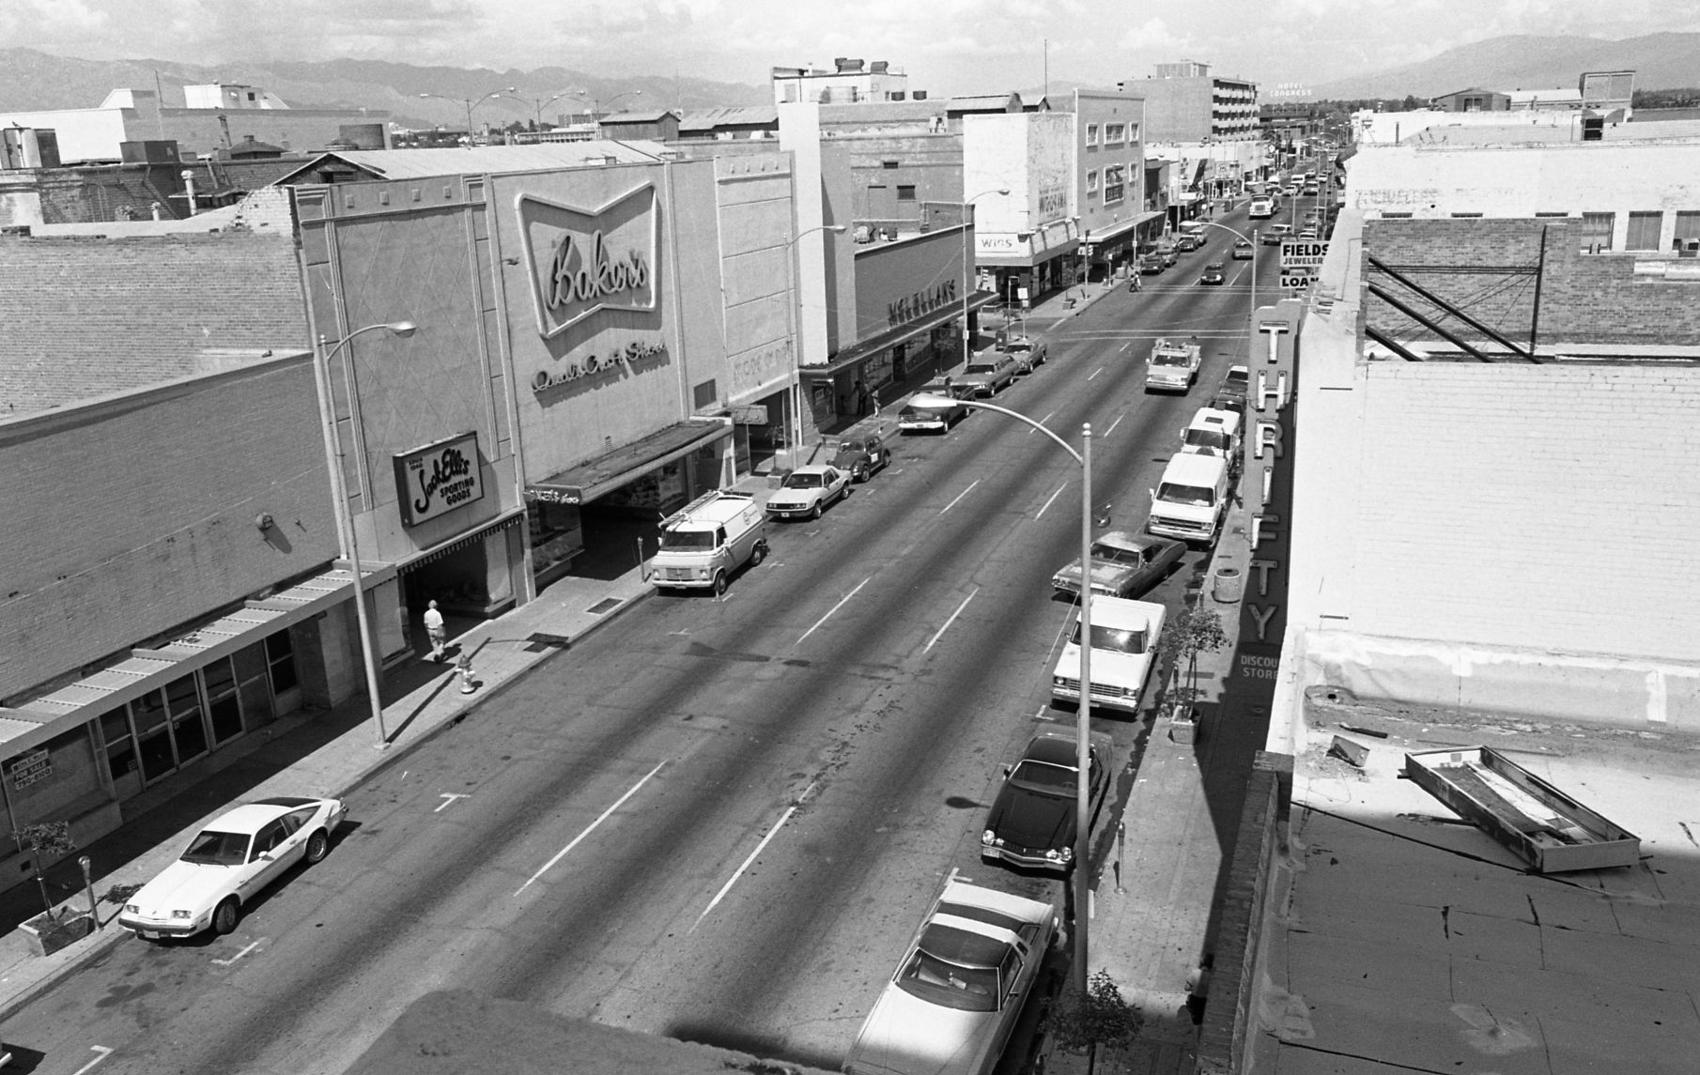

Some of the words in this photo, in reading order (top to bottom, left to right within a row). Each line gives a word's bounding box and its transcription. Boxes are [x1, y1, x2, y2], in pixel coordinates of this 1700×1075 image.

[1283, 244, 1329, 256] FIELDS
[440, 477, 474, 498] SPORTING
[1249, 320, 1289, 640] THRIFTY
[447, 488, 470, 505] GOODS
[1241, 655, 1278, 668] DISCOU
